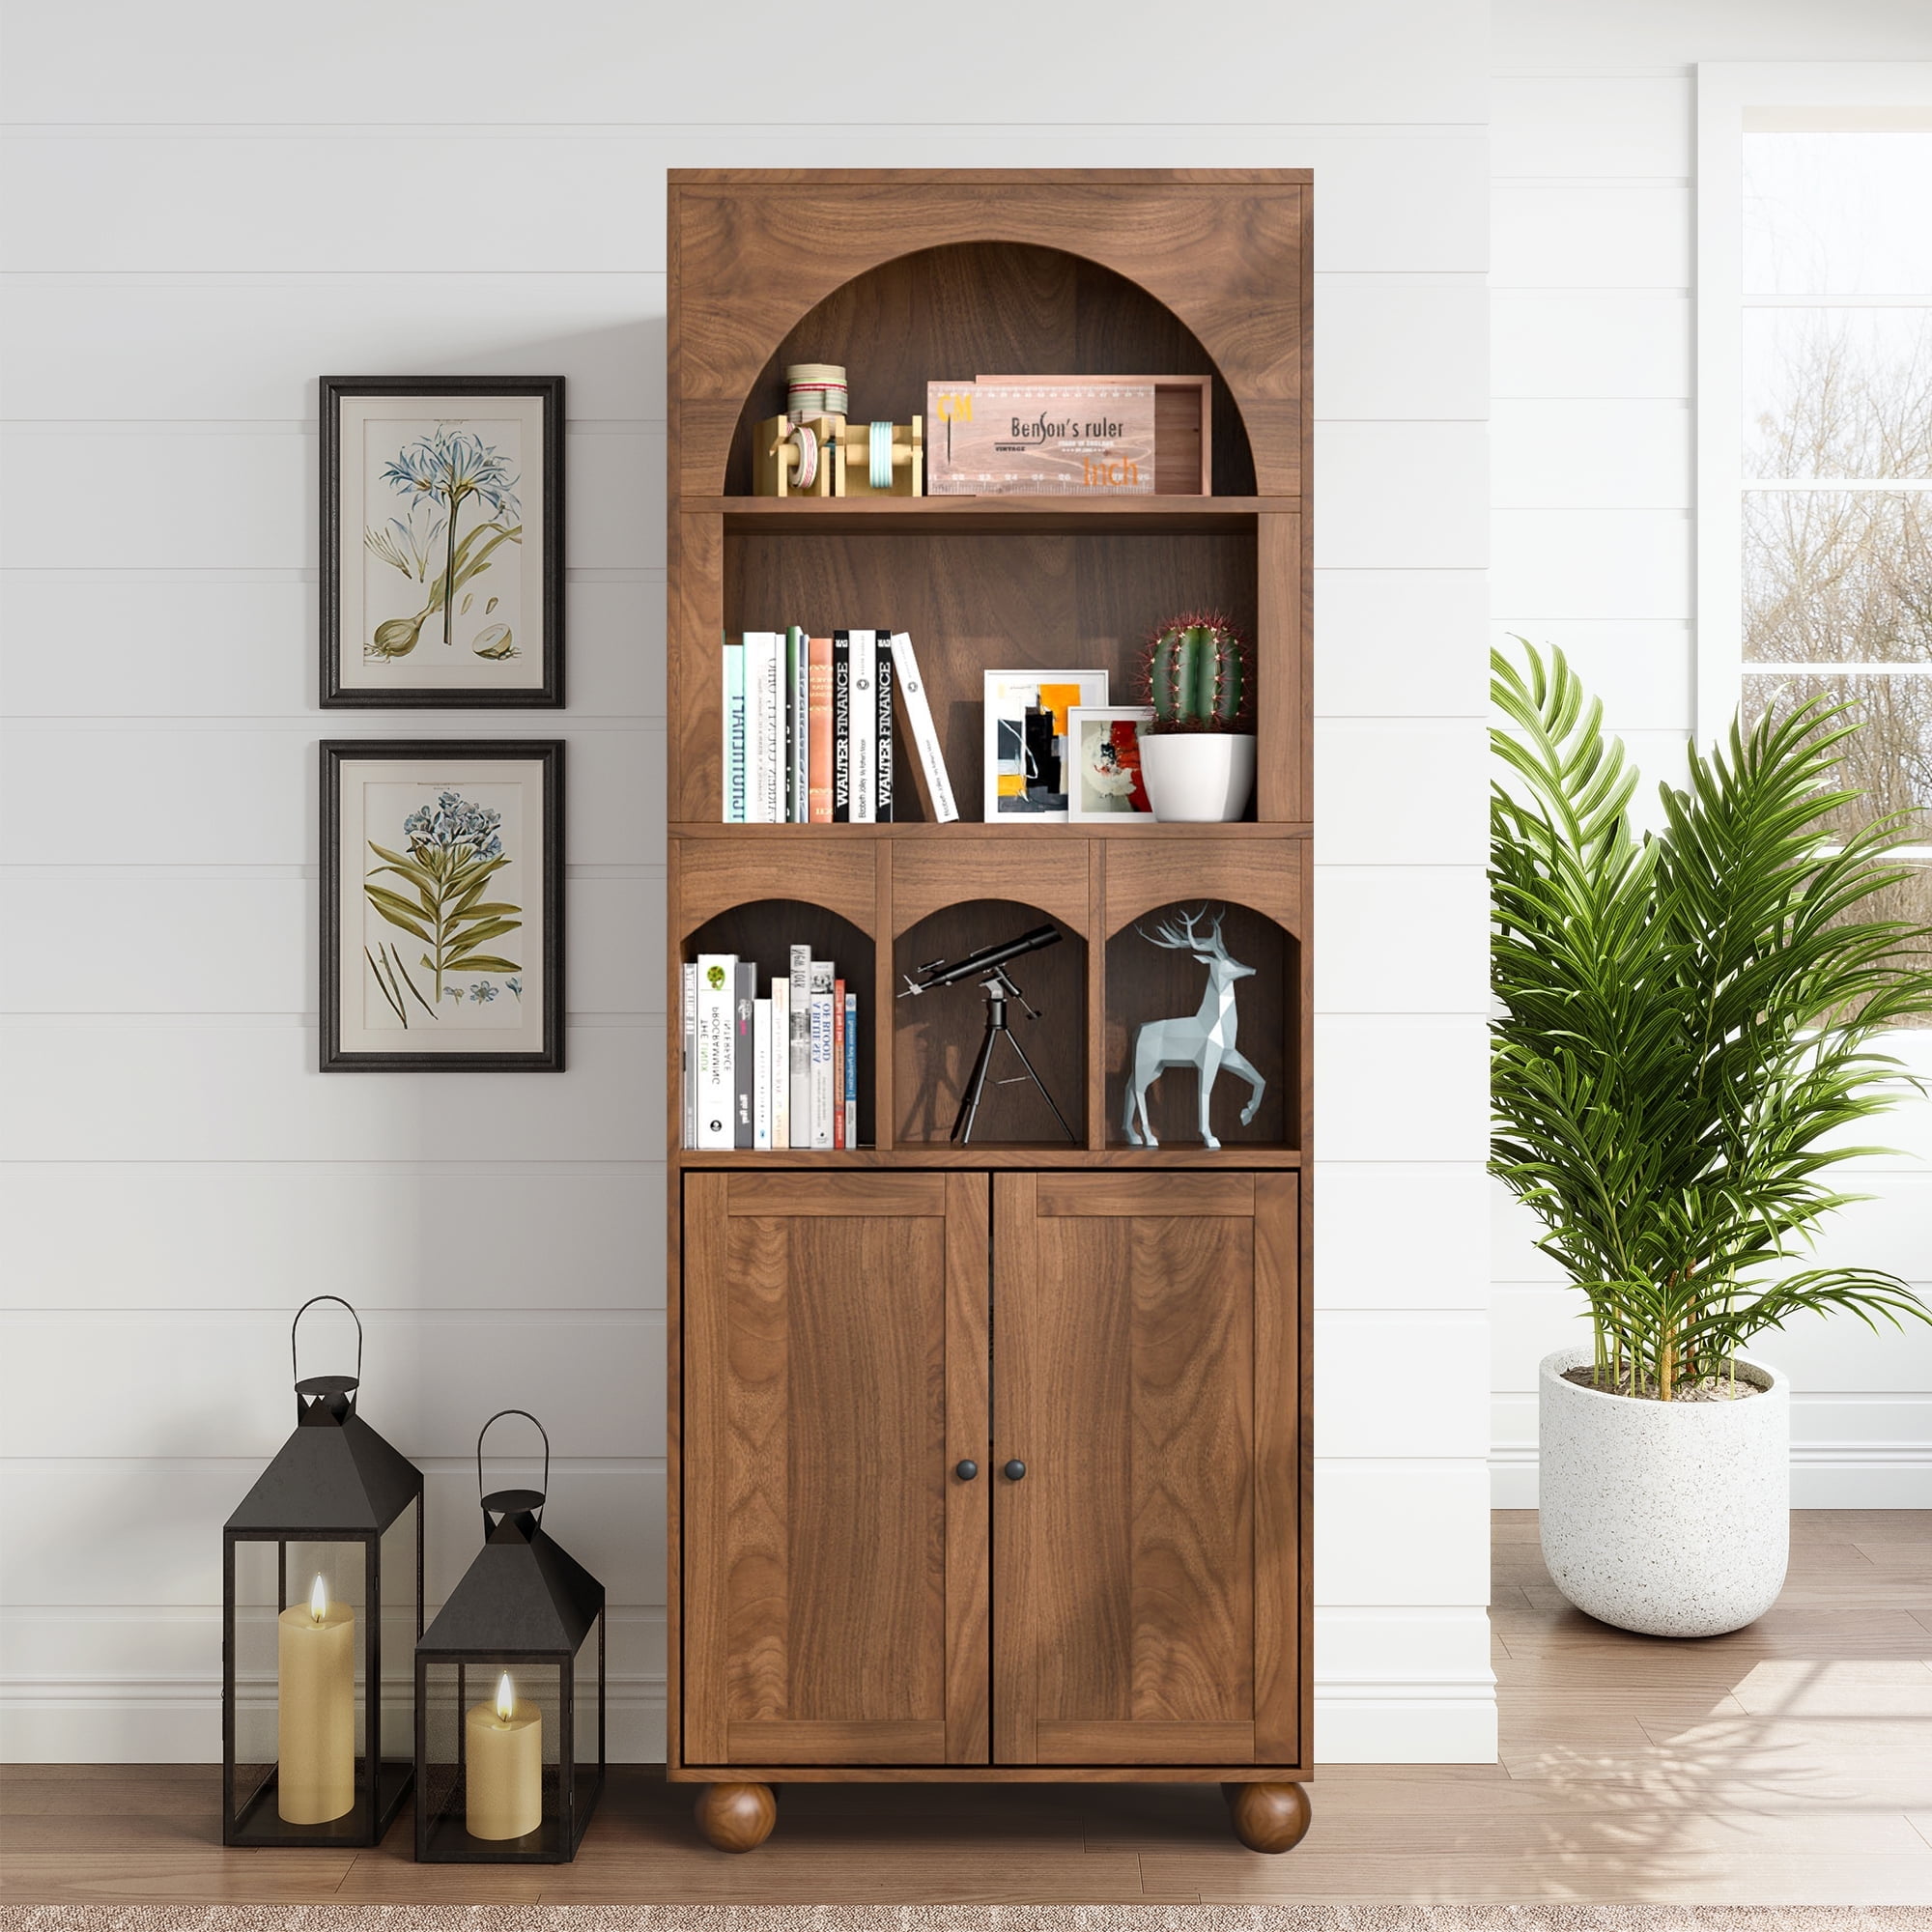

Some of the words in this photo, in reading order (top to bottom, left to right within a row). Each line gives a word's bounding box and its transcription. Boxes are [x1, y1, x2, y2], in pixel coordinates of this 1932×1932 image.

[936, 394, 973, 422] CM
[1086, 416, 1123, 438] ruler
[1083, 456, 1138, 486] Inch
[837, 661, 848, 736] FINANCE
[879, 661, 891, 736] FINANCE
[837, 737, 848, 808] WALTER
[879, 737, 891, 808] WALTER
